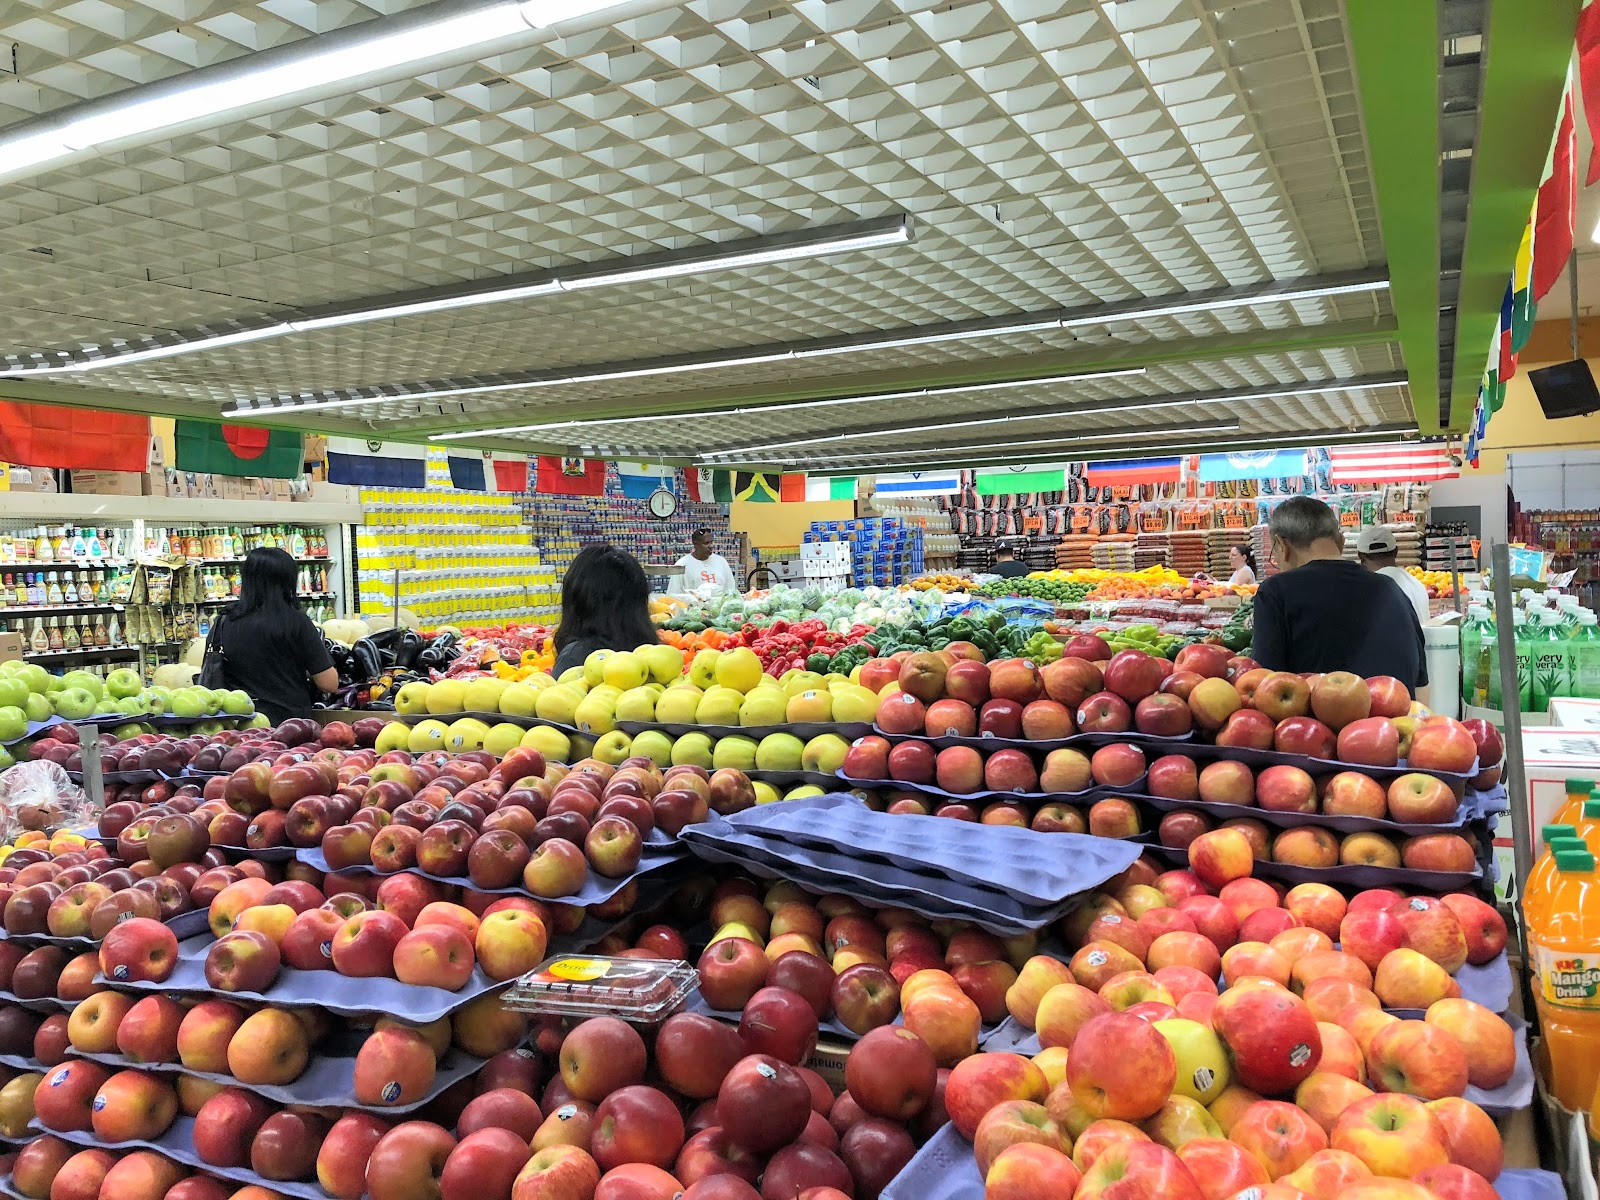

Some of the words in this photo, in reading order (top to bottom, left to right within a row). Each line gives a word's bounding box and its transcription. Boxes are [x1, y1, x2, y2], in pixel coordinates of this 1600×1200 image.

[701, 570, 717, 584] SH
[1551, 971, 1600, 986] Mango
[1557, 986, 1588, 997] Drink
